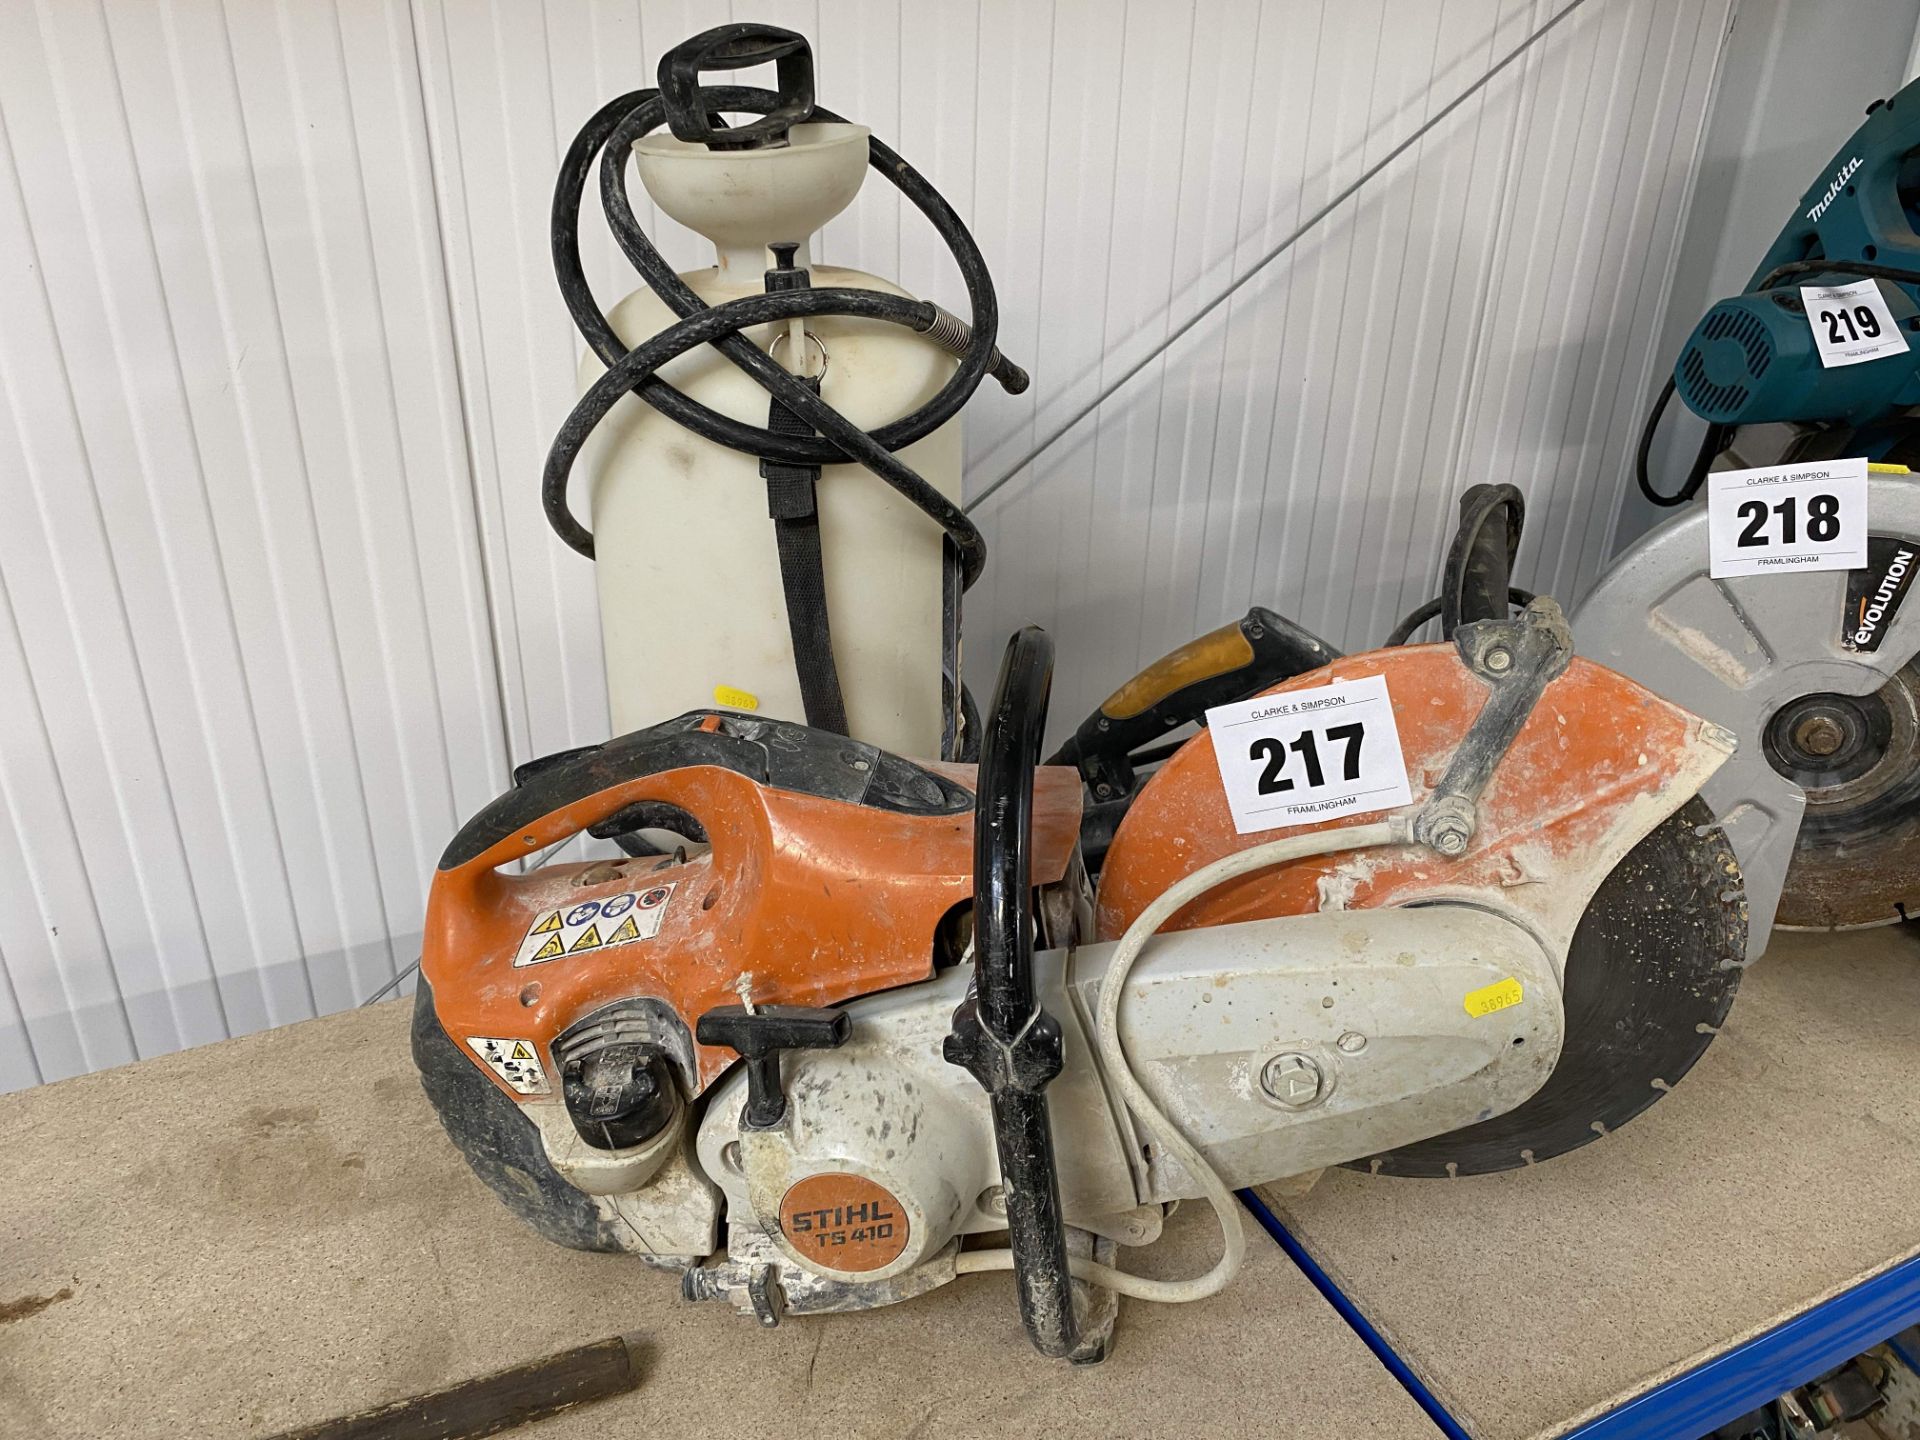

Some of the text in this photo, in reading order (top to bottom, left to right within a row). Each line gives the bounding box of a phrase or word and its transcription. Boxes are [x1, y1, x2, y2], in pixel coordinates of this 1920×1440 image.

[1806, 156, 1864, 223] makita
[1820, 305, 1881, 344] 219
[1746, 471, 1830, 486] CLARKE & SIMPSON
[1737, 494, 1841, 548] 218
[1757, 555, 1819, 566] FRAMLINGHAM
[1251, 696, 1347, 720] CLARKE & SIMPSON
[1249, 722, 1365, 795] 217
[1287, 797, 1357, 815] FRAMLINGHAM
[1480, 989, 1520, 1013] 38965
[793, 1201, 893, 1233] STIHL
[815, 1223, 893, 1247] TS 410
